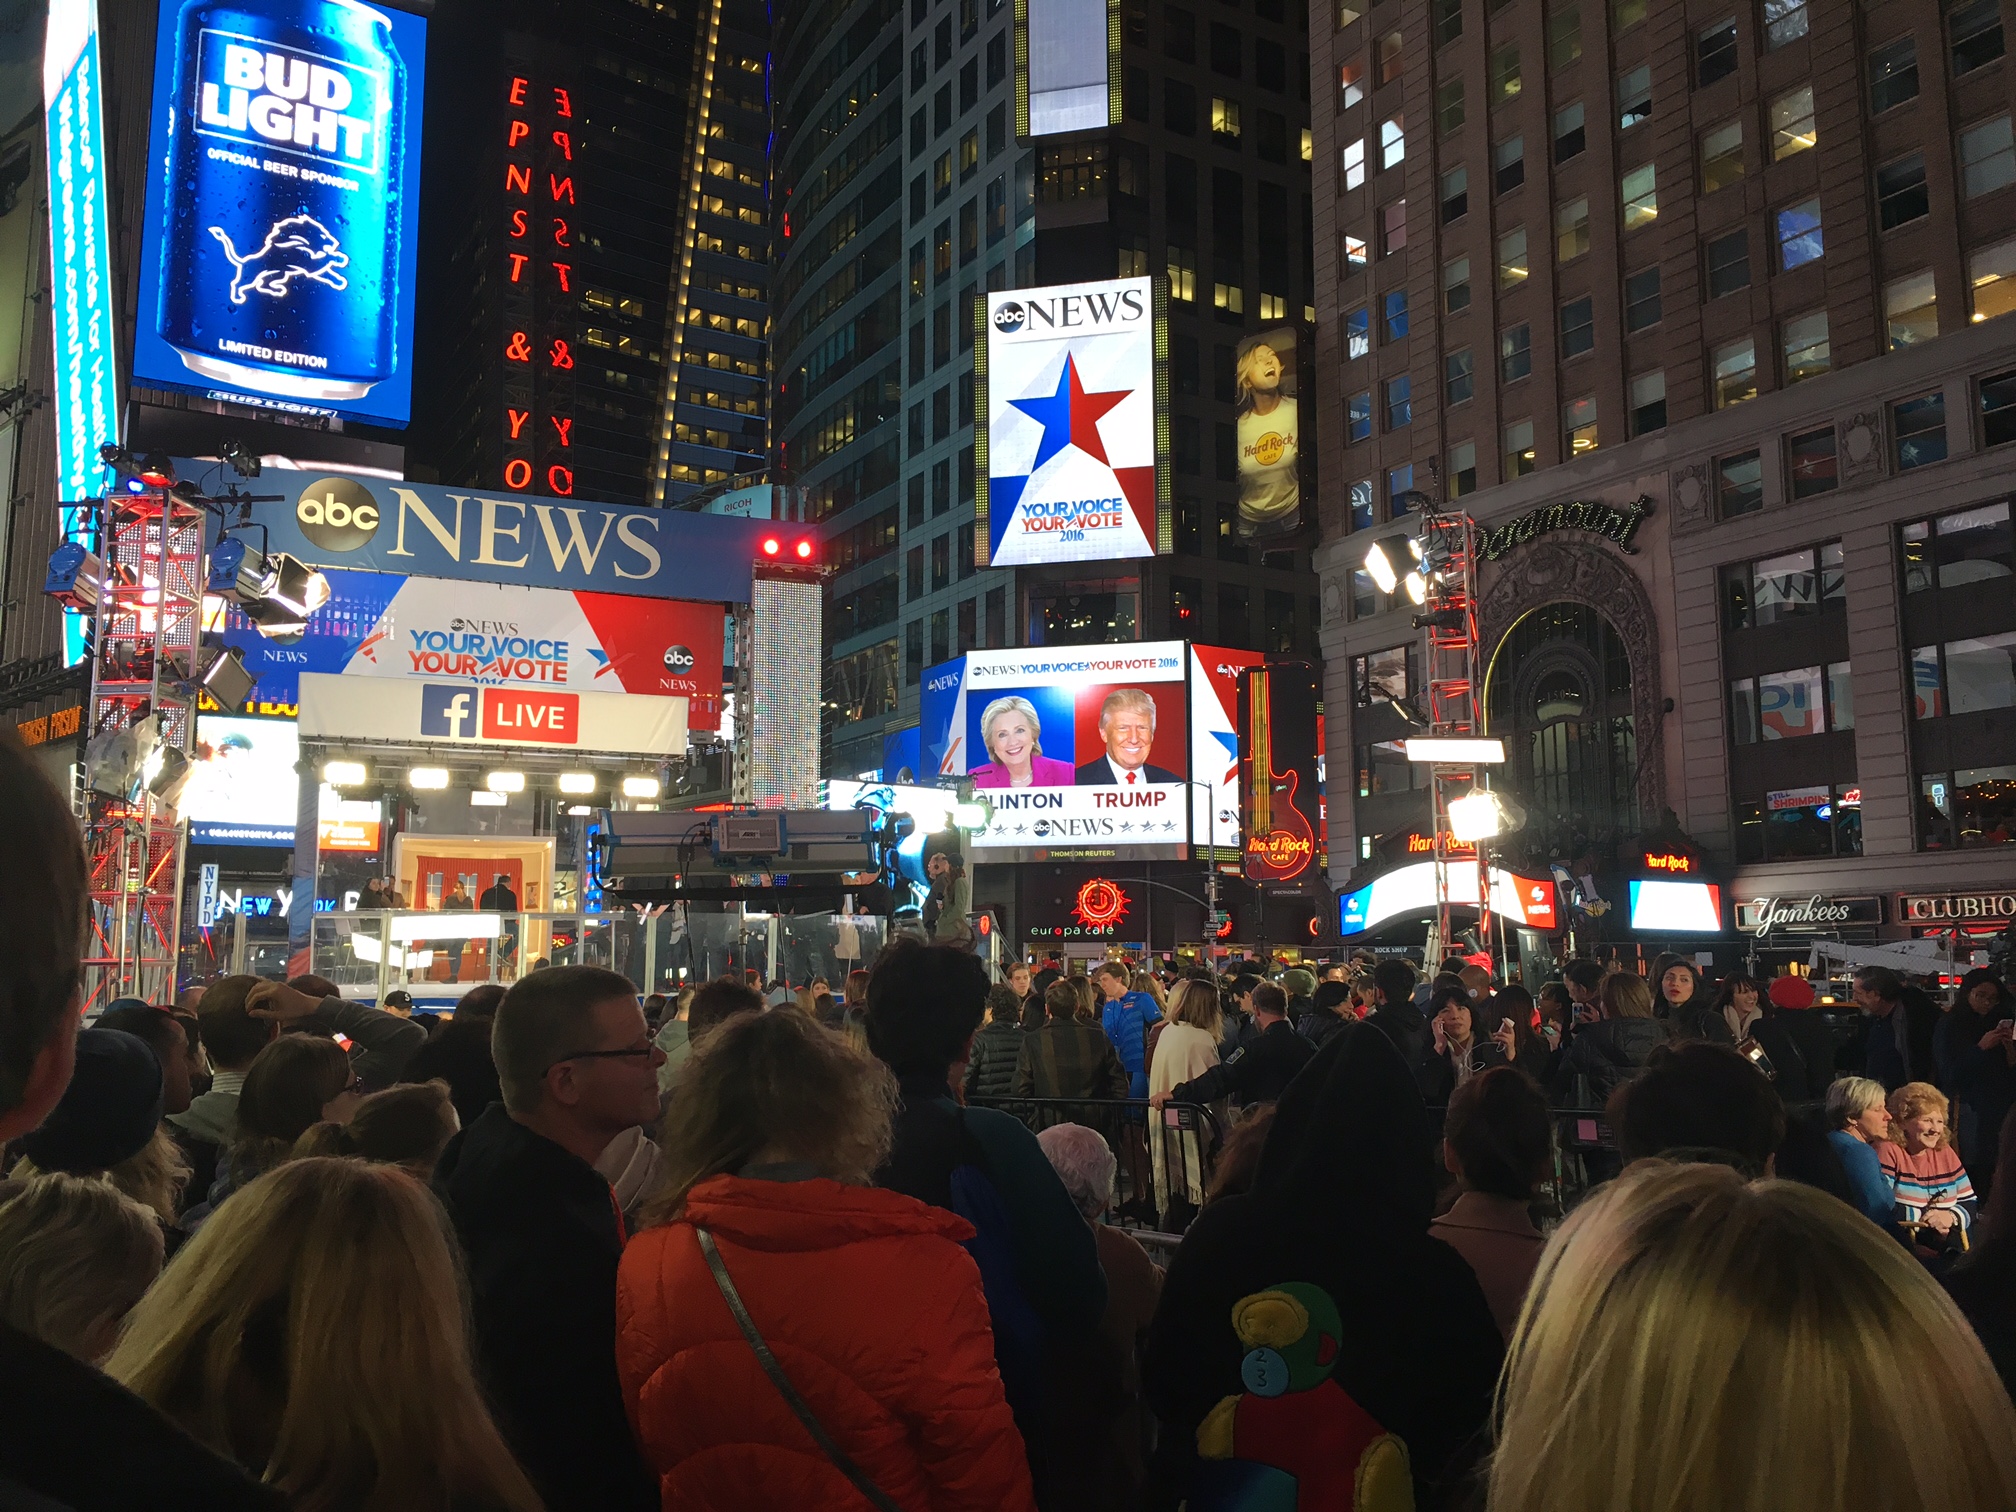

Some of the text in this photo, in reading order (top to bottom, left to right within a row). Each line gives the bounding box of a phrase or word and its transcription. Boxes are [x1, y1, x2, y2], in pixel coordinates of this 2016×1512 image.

[224, 44, 352, 111] BUD
[202, 82, 370, 159] LIGHT
[207, 147, 360, 192] OFFICIAL BEER SPONSOR
[994, 289, 1144, 331] abc NEWS
[218, 338, 327, 368] LIMITED EDITION
[506, 332, 531, 362] &
[1244, 433, 1294, 458] Hard Rock
[724, 498, 752, 512] RICOH
[1021, 498, 1122, 518] YOUR VOICE
[1021, 512, 1122, 532] YOUR VOTE
[1455, 496, 1650, 560] Paramount
[297, 487, 662, 581] abc NEWS
[1059, 530, 1084, 542] 2016
[466, 619, 518, 636] NEWS
[410, 629, 569, 661] YOUR VOICE
[263, 650, 308, 664] NEWS
[408, 650, 567, 682] YOUR VOTE
[664, 651, 694, 666] abc
[982, 665, 1016, 677] NEWS
[1020, 663, 1050, 674] YOUR
[1051, 661, 1085, 673] VOICE
[1090, 660, 1122, 671] YOUR
[1124, 658, 1156, 669] VOTE
[1158, 657, 1178, 668] 2016
[659, 678, 697, 691] NEWS
[934, 672, 959, 692] NEWS
[497, 703, 565, 729] LIVE
[1093, 791, 1167, 808] TRUMP
[1767, 792, 1790, 801] STILL
[1033, 818, 1114, 836] abc NEWS
[1281, 836, 1310, 854] Rock
[1668, 855, 1689, 872] Rock
[202, 866, 215, 925] NYPD
[1752, 894, 1850, 938] Yankees
[1031, 926, 1081, 938] europa
